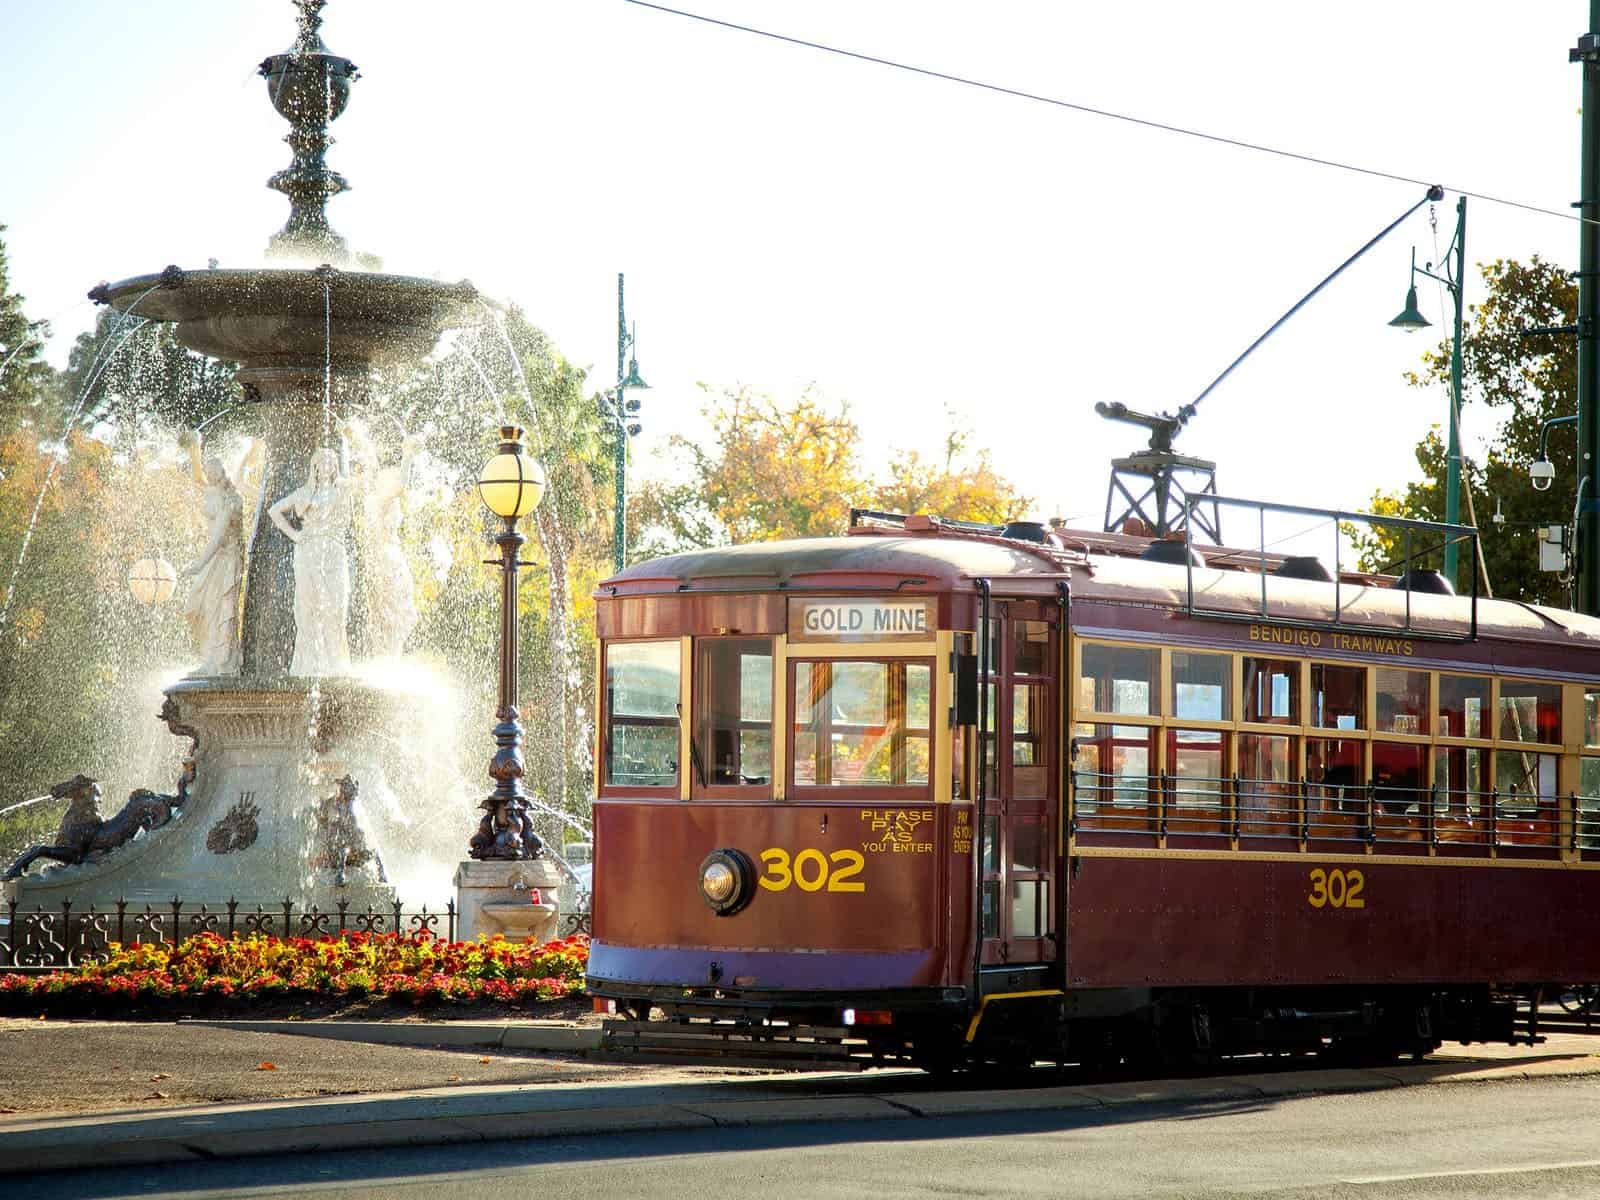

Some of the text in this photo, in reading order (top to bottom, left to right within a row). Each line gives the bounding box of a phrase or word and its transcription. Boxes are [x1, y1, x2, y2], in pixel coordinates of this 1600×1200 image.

[805, 607, 926, 632] GOLD MINE
[1249, 623, 1414, 656] BENDIGO TRAMWAYS
[861, 810, 934, 821] PLEASE
[871, 821, 921, 832] PAY
[881, 831, 913, 842] AS
[862, 842, 933, 853] YOU ENTER
[758, 847, 865, 892] 302
[1308, 868, 1366, 909] 302
